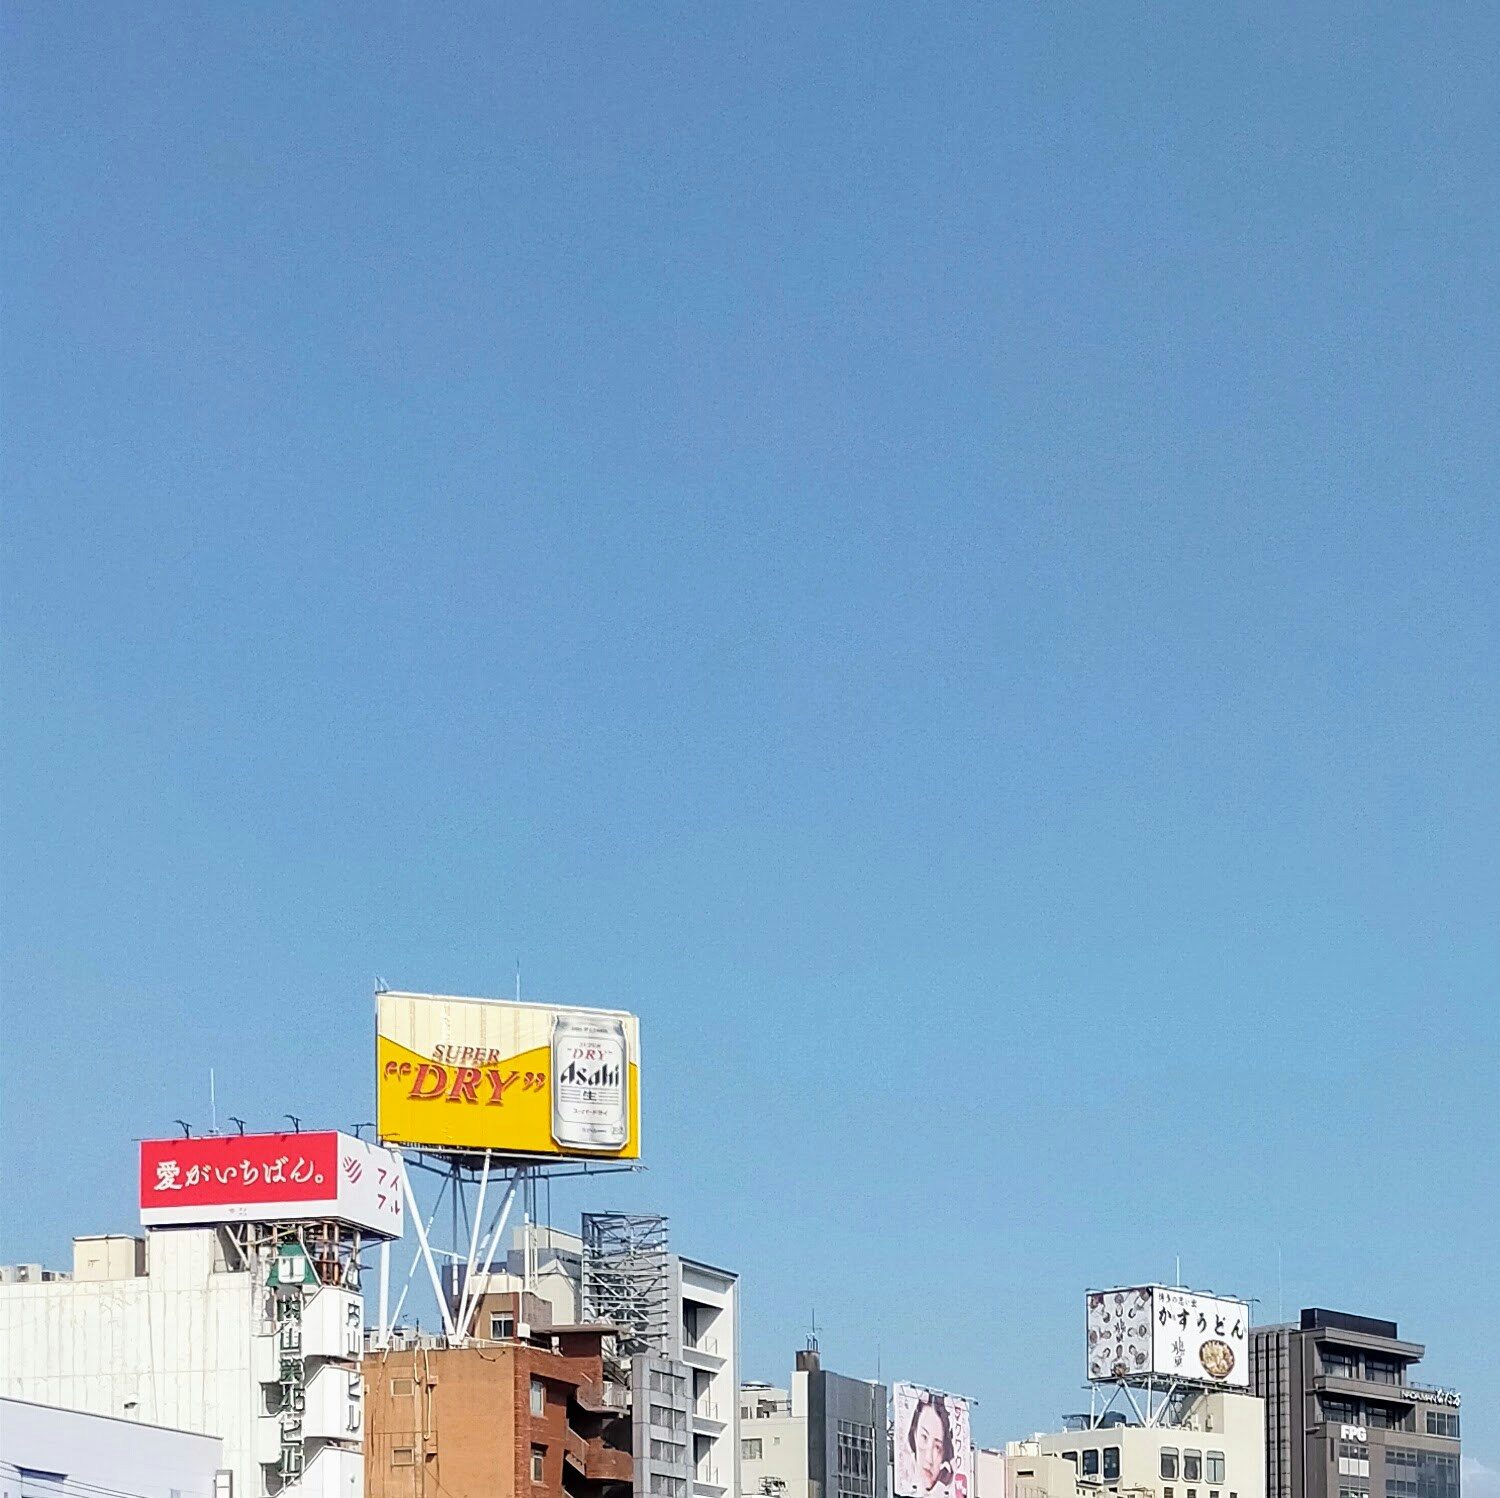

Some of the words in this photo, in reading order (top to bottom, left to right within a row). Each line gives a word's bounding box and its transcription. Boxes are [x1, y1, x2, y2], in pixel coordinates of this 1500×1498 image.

[432, 1043, 501, 1062] SUPER
[560, 1060, 620, 1087] Asahi
[582, 1089, 598, 1101] 生
[153, 1155, 325, 1191] 愛がいちばん。
[1158, 1305, 1245, 1340] かすうどん
[1340, 1424, 1367, 1442] FPG
